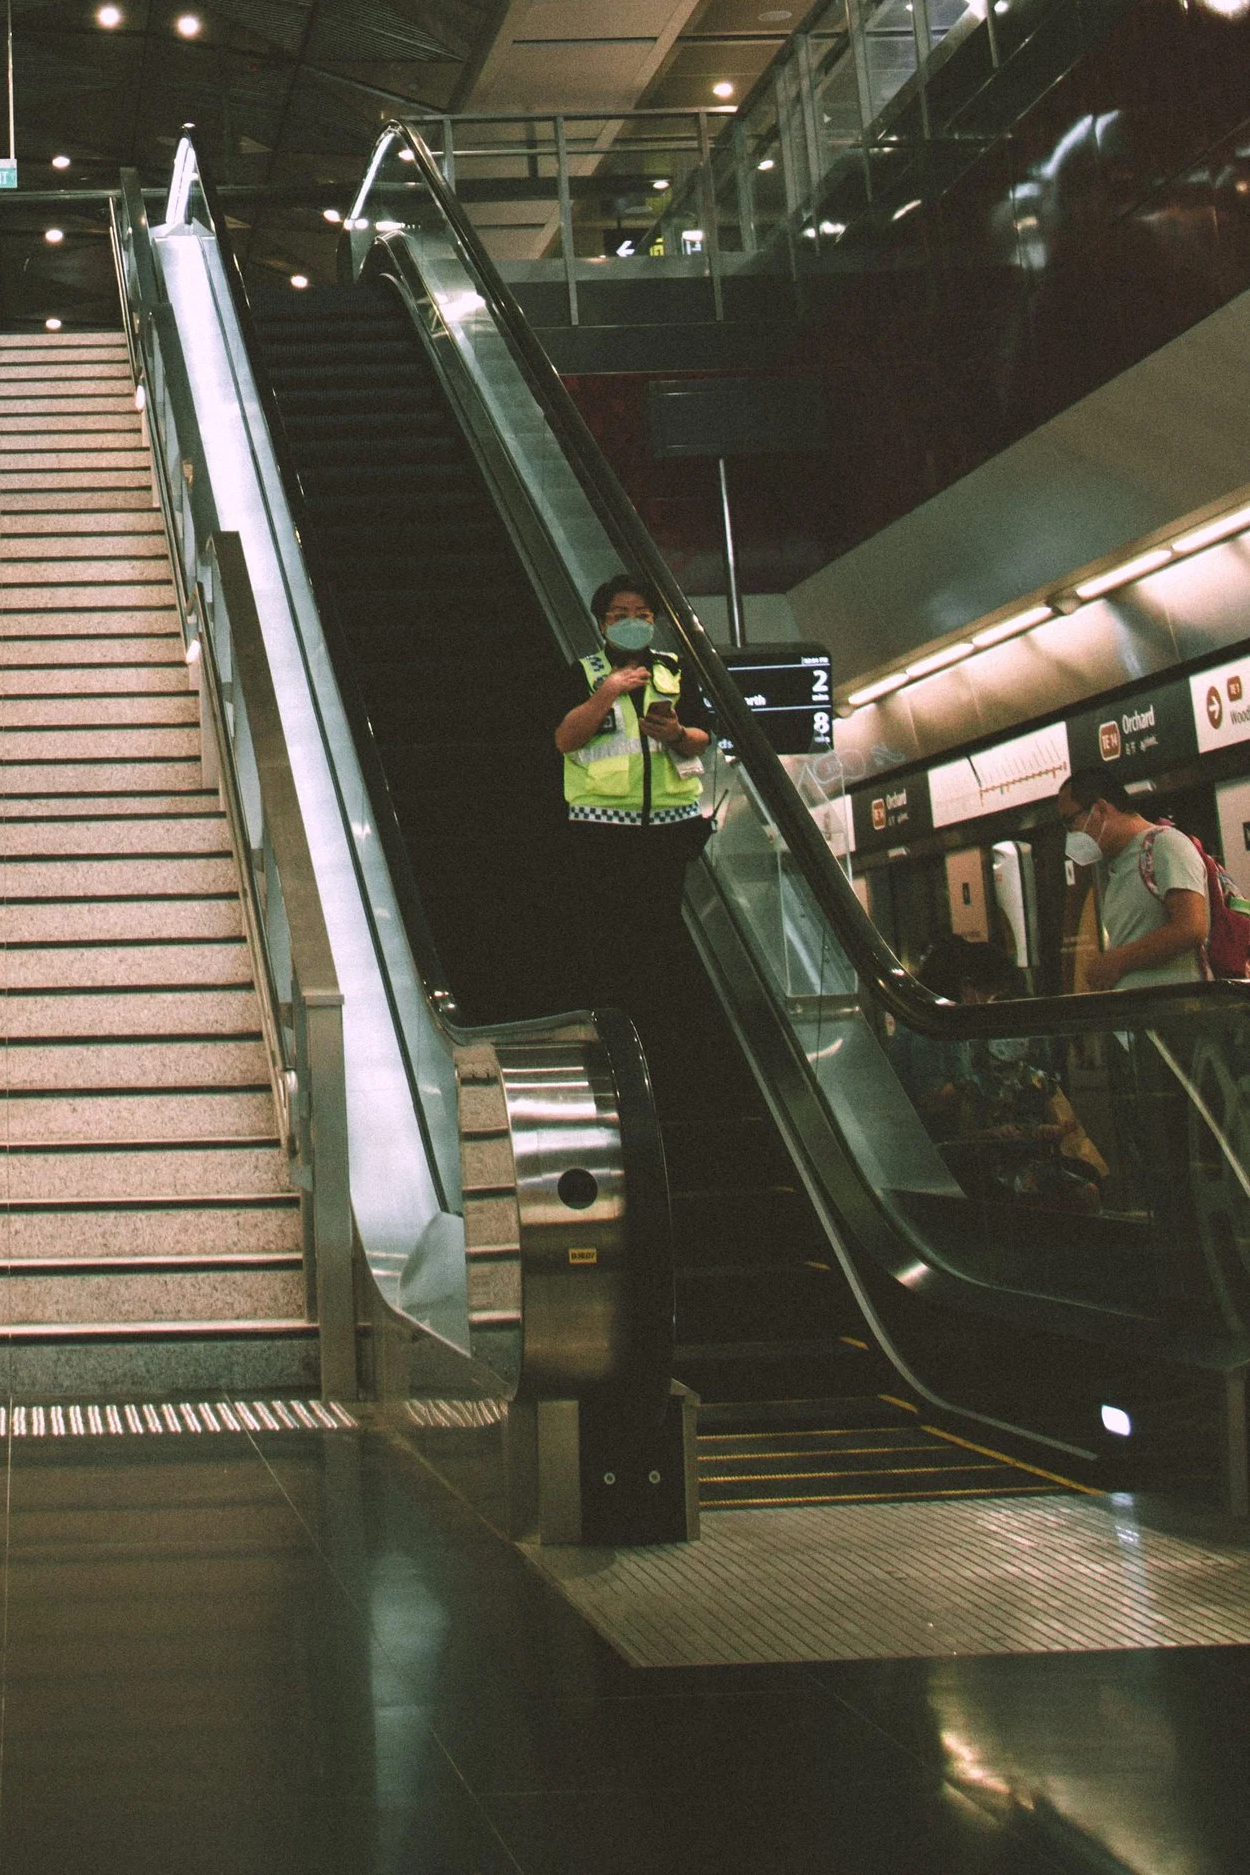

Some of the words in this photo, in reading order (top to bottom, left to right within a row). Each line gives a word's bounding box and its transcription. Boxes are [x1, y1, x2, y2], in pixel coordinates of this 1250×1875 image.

[812, 670, 829, 692] 2
[744, 694, 767, 706] orth
[813, 711, 830, 734] 8
[1122, 705, 1155, 734] Orchard
